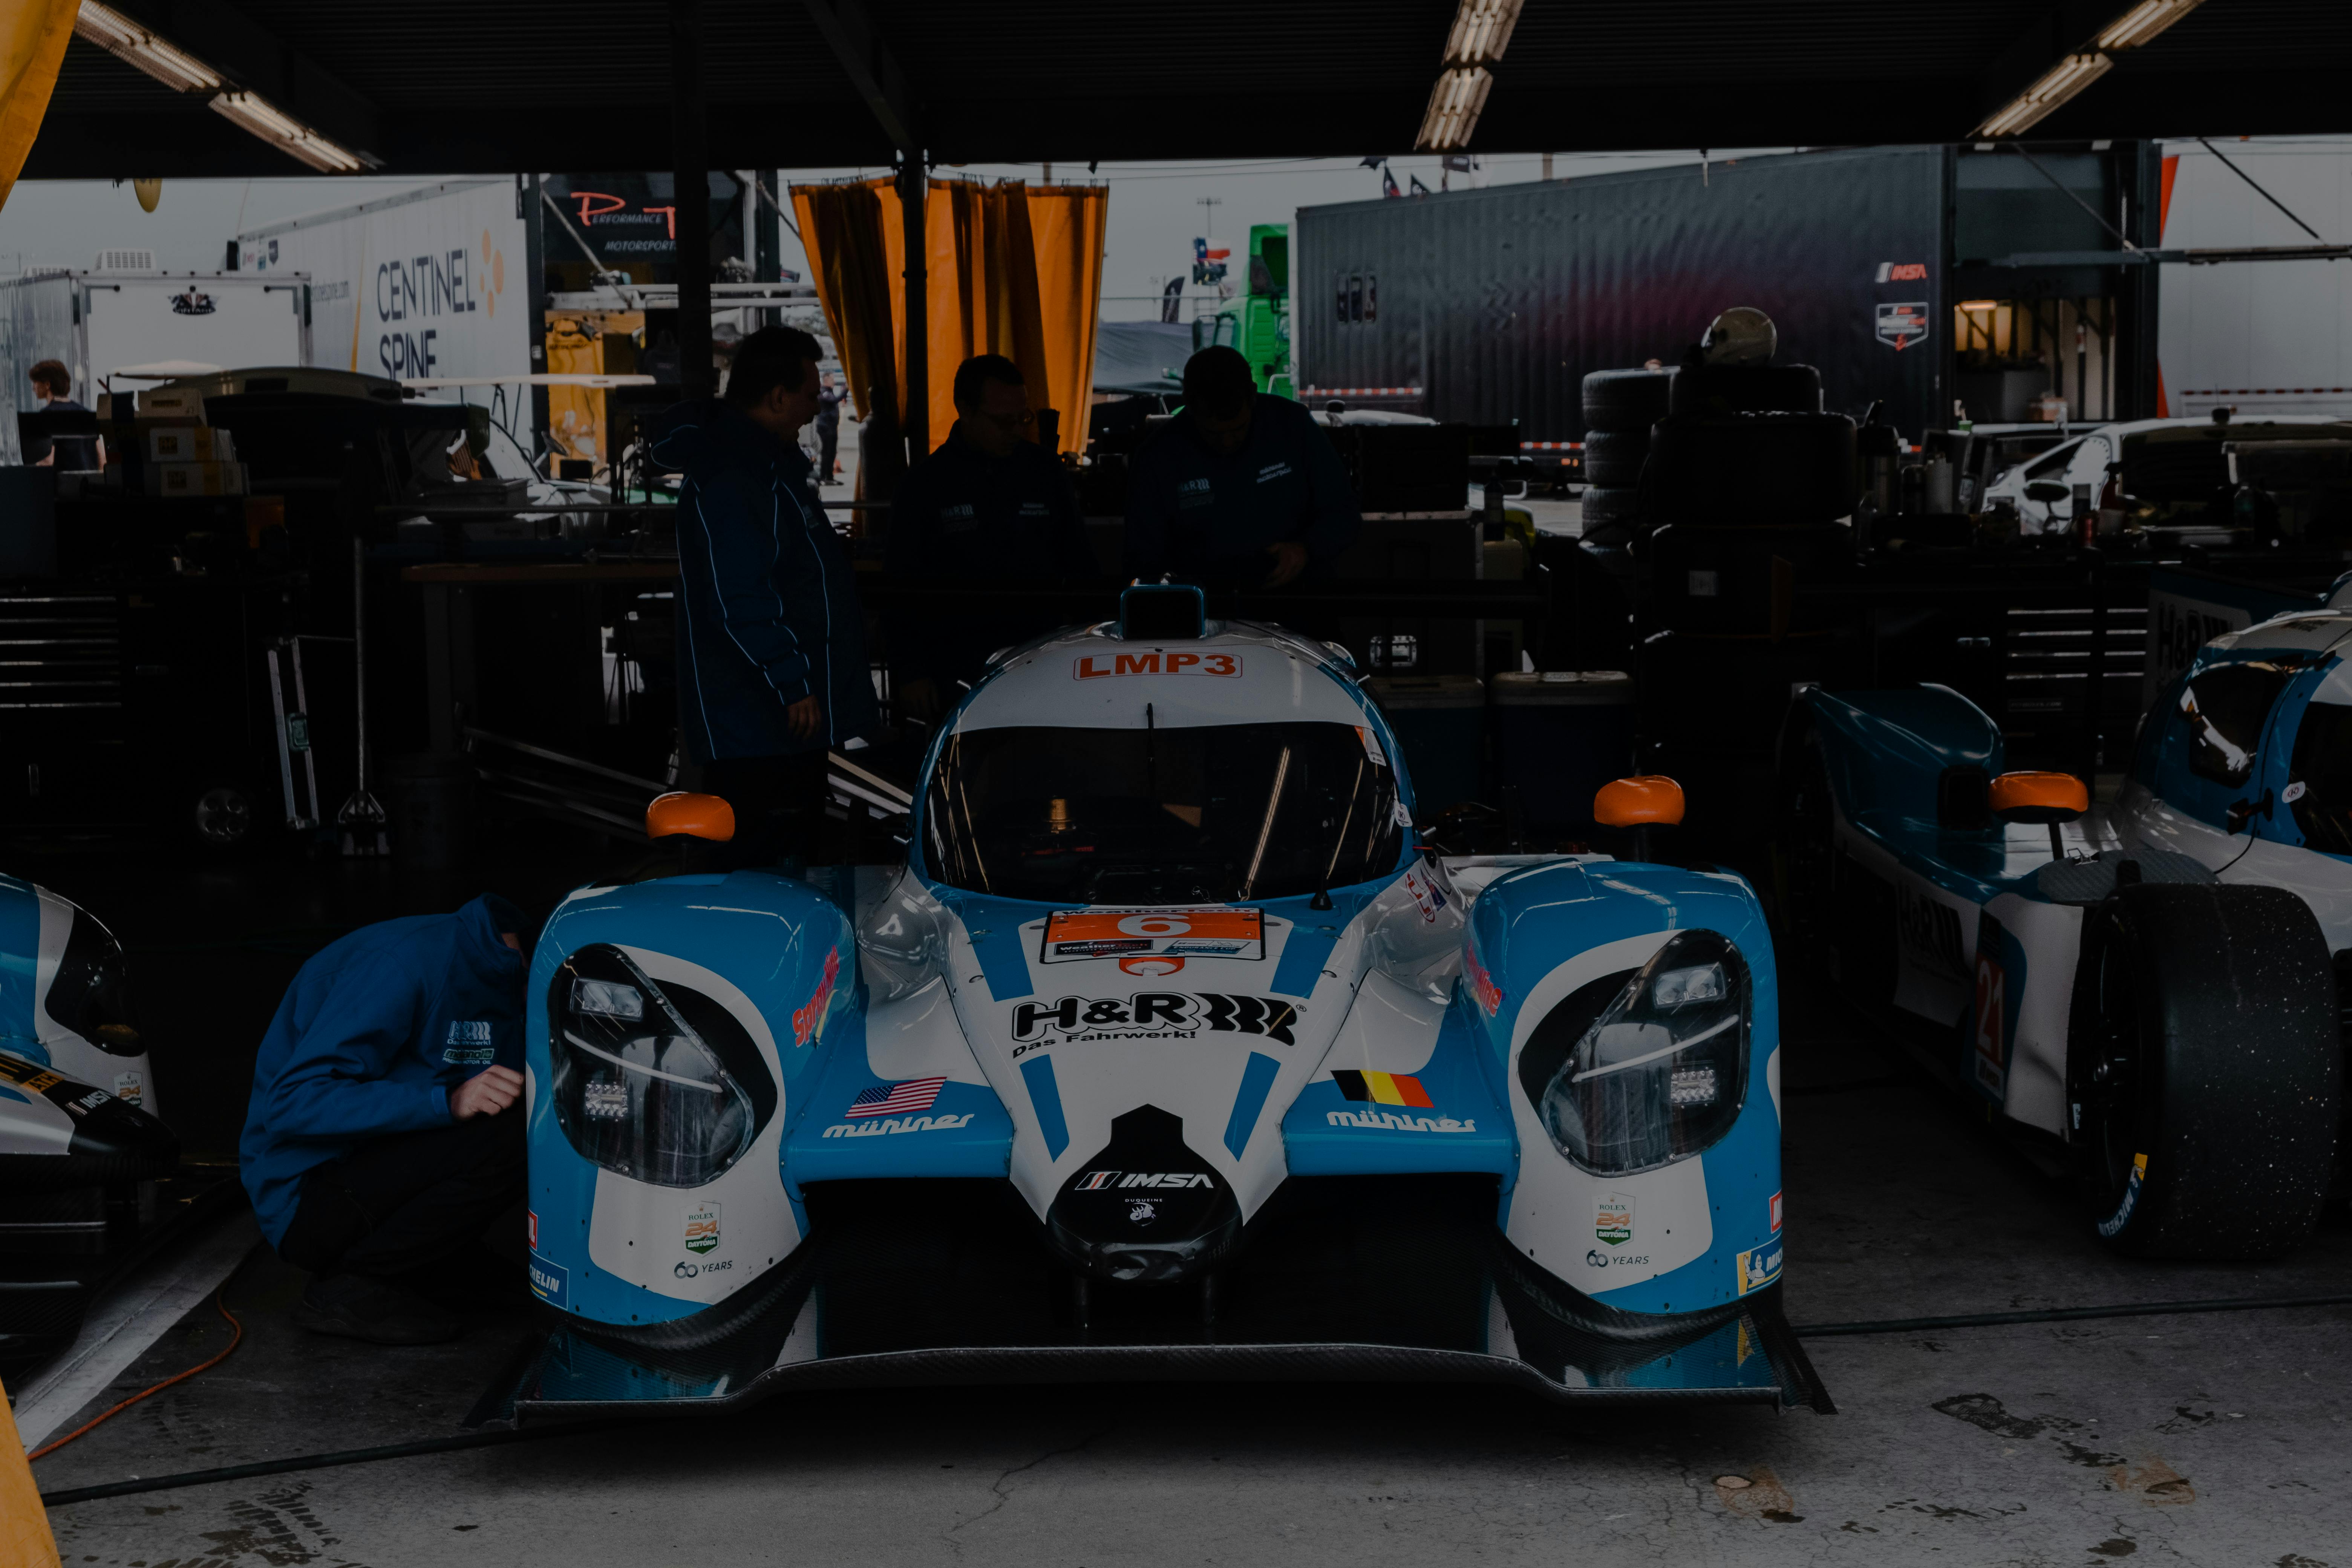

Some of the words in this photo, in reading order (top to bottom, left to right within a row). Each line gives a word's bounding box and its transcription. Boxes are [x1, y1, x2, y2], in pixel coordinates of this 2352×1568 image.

[378, 249, 475, 322] CENTINEL
[1080, 654, 1236, 678] LMP3
[1118, 914, 1191, 937] 6
[1013, 992, 1195, 1040] H&R
[1978, 959, 2003, 1063] 21
[1013, 1038, 1056, 1059] Das
[1066, 1031, 1196, 1043] Fahrwerk!
[822, 1113, 975, 1138] mühlner
[1326, 1110, 1476, 1132] mühlner
[1118, 1173, 1214, 1188] IMSA
[685, 1220, 717, 1237] 24
[1596, 1213, 1631, 1226] 24
[688, 1239, 716, 1248] DAYTONA
[674, 1261, 698, 1279] 60
[702, 1260, 733, 1273] YEARS
[1587, 1250, 1608, 1267] 60
[1612, 1256, 1649, 1265] YEARS
